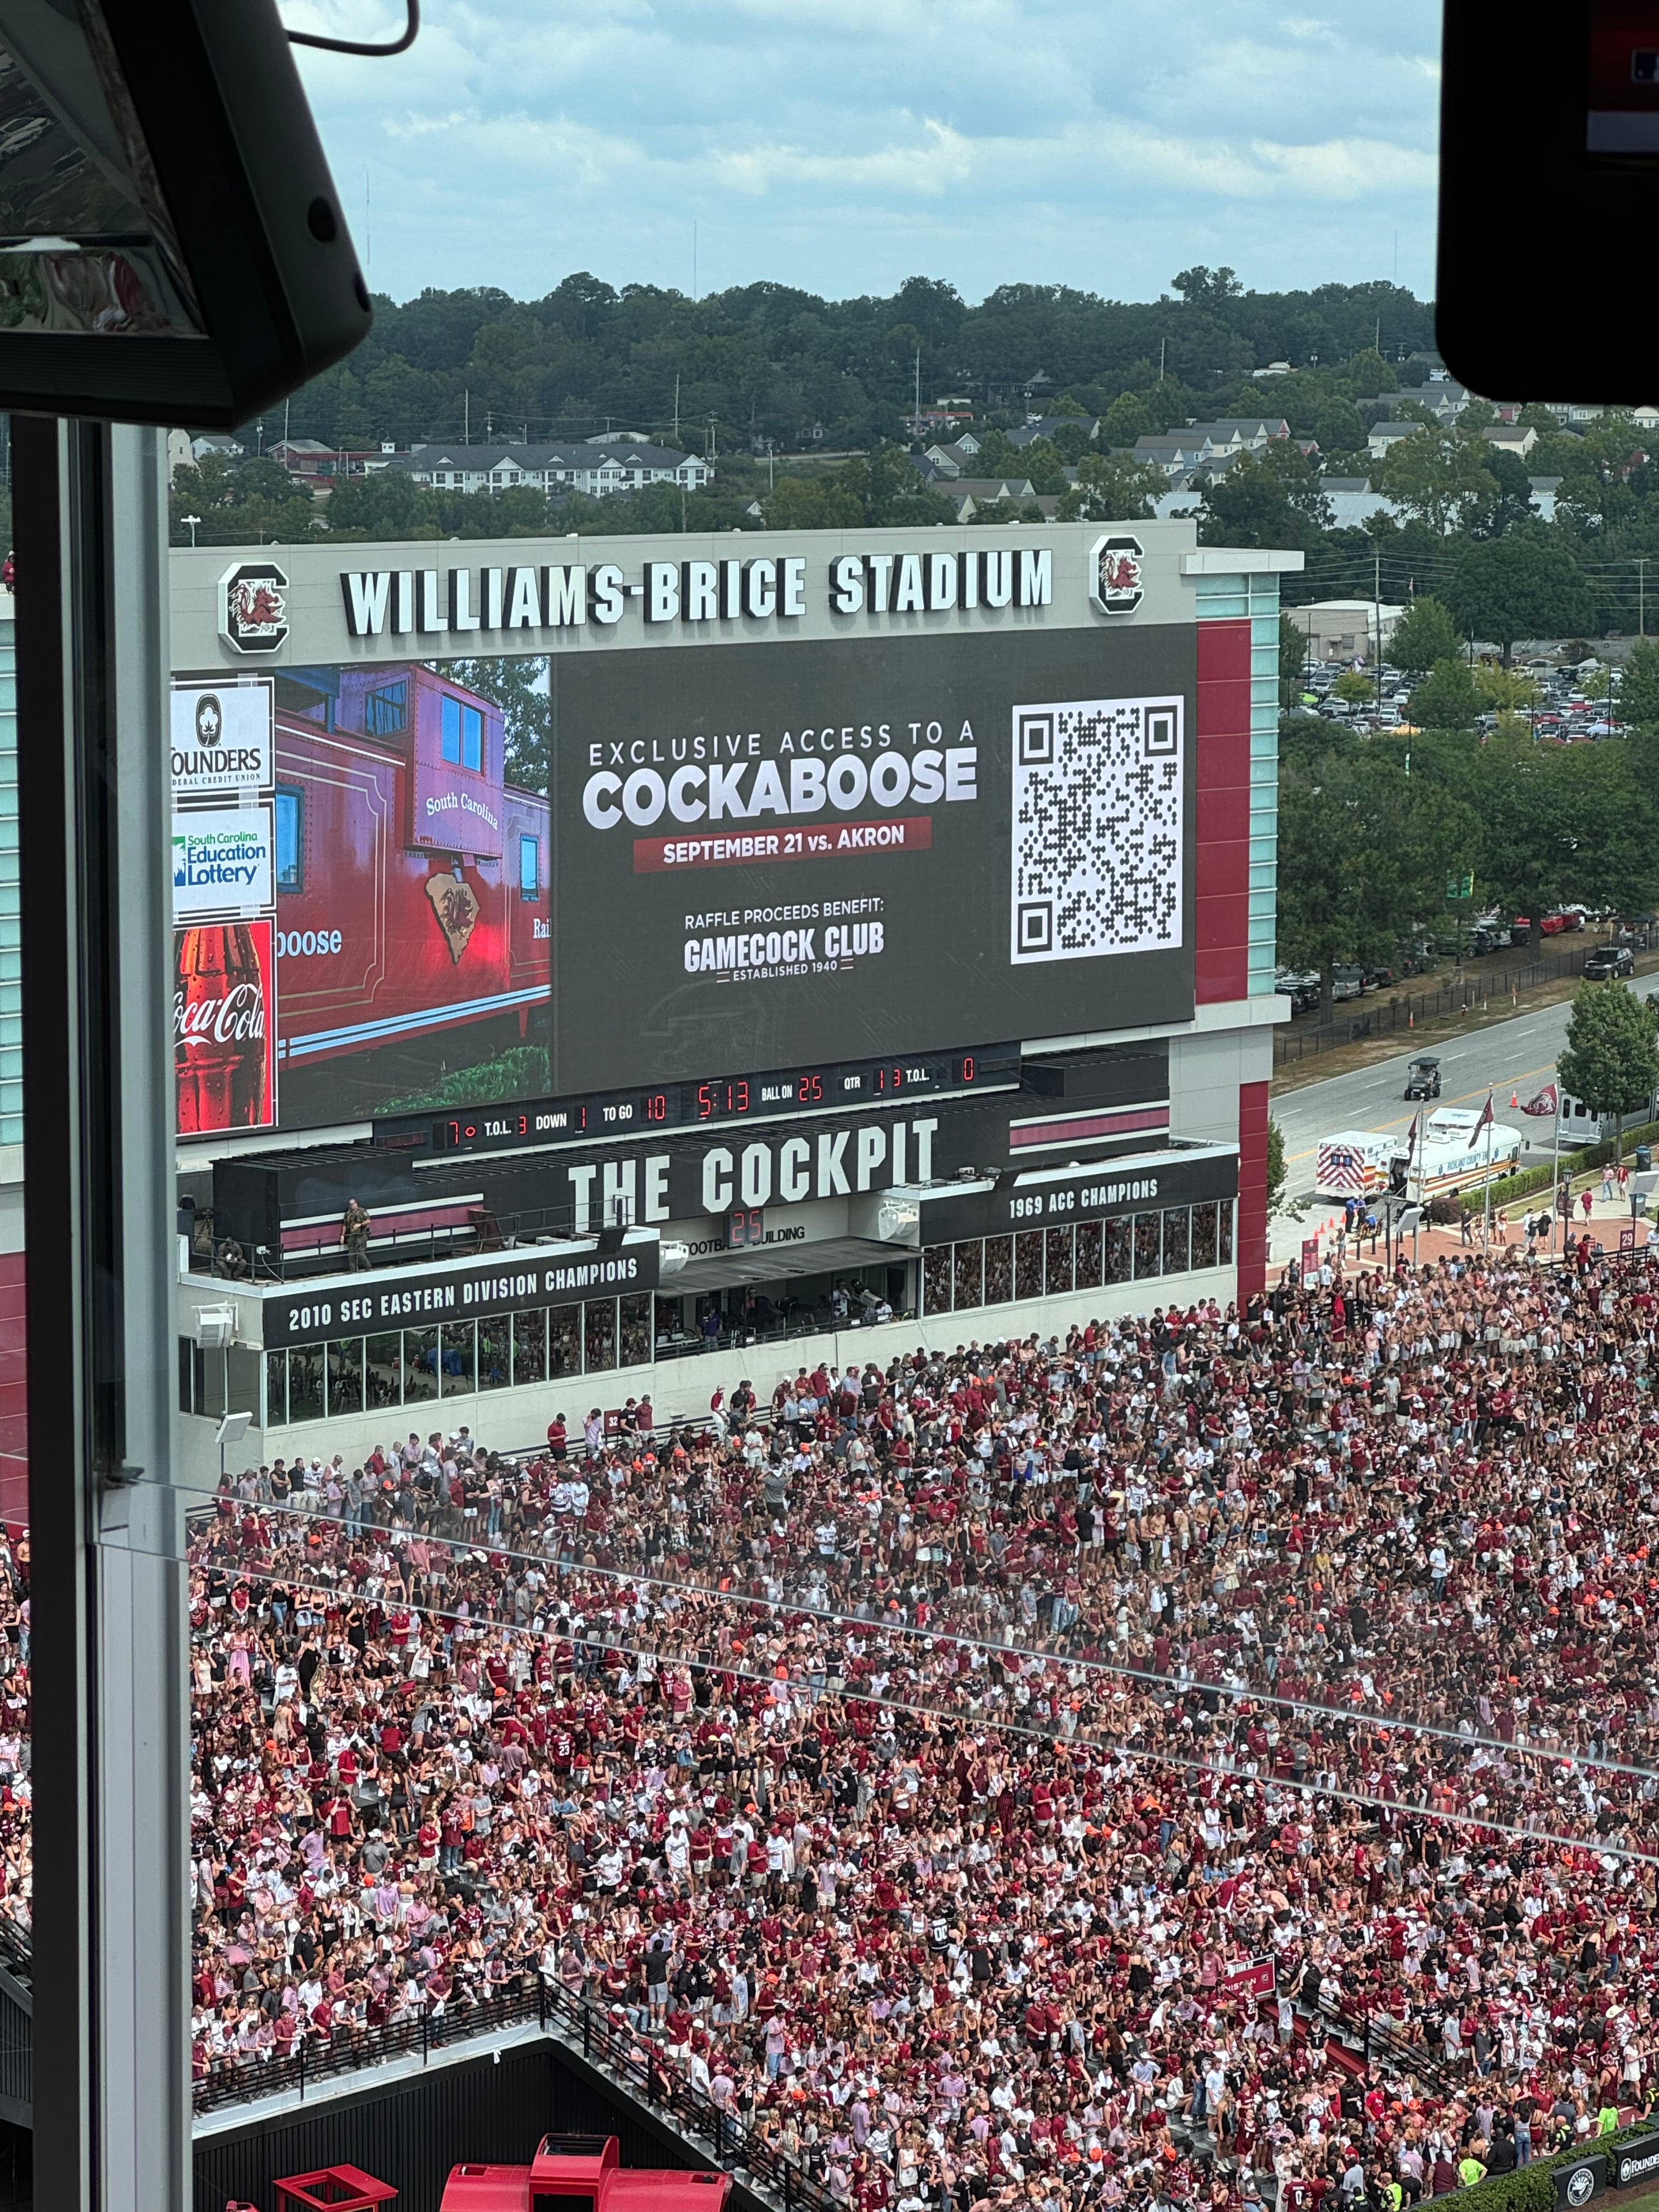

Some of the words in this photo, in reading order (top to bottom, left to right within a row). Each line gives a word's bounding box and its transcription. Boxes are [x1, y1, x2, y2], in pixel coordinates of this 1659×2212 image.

[340, 557, 807, 635] WILLIAMS-BRICE
[829, 549, 1052, 613] STADIUM
[589, 733, 761, 766] EXCLUSIVE
[779, 724, 891, 754] ACCESS
[908, 721, 943, 744] TO
[959, 720, 974, 742] A
[171, 747, 261, 776] OUNDERS
[172, 777, 199, 786] DERAL
[202, 775, 233, 784] CREDIT
[583, 747, 977, 830] COCKABOOSE
[425, 792, 459, 816] South
[460, 793, 499, 831] Carolina
[187, 833, 216, 846] South
[217, 831, 258, 844] Carolina
[663, 836, 778, 864] SEPTEMBER
[783, 832, 803, 853] 21
[807, 834, 832, 851] vs.
[837, 825, 905, 849] AKRON
[187, 843, 266, 864] Education
[188, 864, 257, 886] Lottery
[685, 911, 740, 930] RAFFLE
[744, 904, 819, 924] PROCEEDS
[823, 897, 884, 917] BENEFIT:
[684, 928, 815, 972] GAMECOCK
[825, 922, 884, 958] CLUB
[733, 964, 808, 981] ESTABLISHED
[811, 960, 838, 973] 1940
[449, 1120, 459, 1144] 7
[484, 1121, 511, 1137] T.O.L.
[518, 1116, 527, 1135] 3
[535, 1113, 567, 1131] DOWN
[582, 1107, 586, 1128] 1
[602, 1107, 617, 1122] TO
[618, 1104, 633, 1120] GO
[647, 1094, 666, 1120] 10
[698, 1081, 749, 1116] 5:13
[761, 1086, 780, 1102] BALL
[782, 1085, 793, 1098] ON
[799, 1075, 822, 1102] 25
[844, 1076, 861, 1090] QTR
[893, 1069, 901, 1087] 3
[906, 1069, 930, 1083] T.O.L.
[963, 1057, 974, 1080] 0
[568, 1155, 670, 1232] THE
[702, 1118, 938, 1213] COCKPIT
[1009, 1195, 1043, 1218] 1969
[1048, 1190, 1075, 1212] ACC
[1081, 1178, 1158, 1207] CHAMPIONS
[731, 1209, 761, 1243] 25
[753, 1226, 805, 1246] UILDING
[1622, 1233, 1633, 1246] 29
[289, 1304, 332, 1331] 2010
[340, 1298, 372, 1323] SEC
[381, 1285, 455, 1316] EASTERN
[463, 1273, 537, 1305] DIVISION
[545, 1257, 638, 1291] CHAMPIONS
[608, 1416, 618, 1427] 32
[558, 1745, 570, 1756] 23
[1402, 1931, 1408, 1946] 5
[1224, 1977, 1256, 1991] NISN
[745, 2086, 752, 2098] 16
